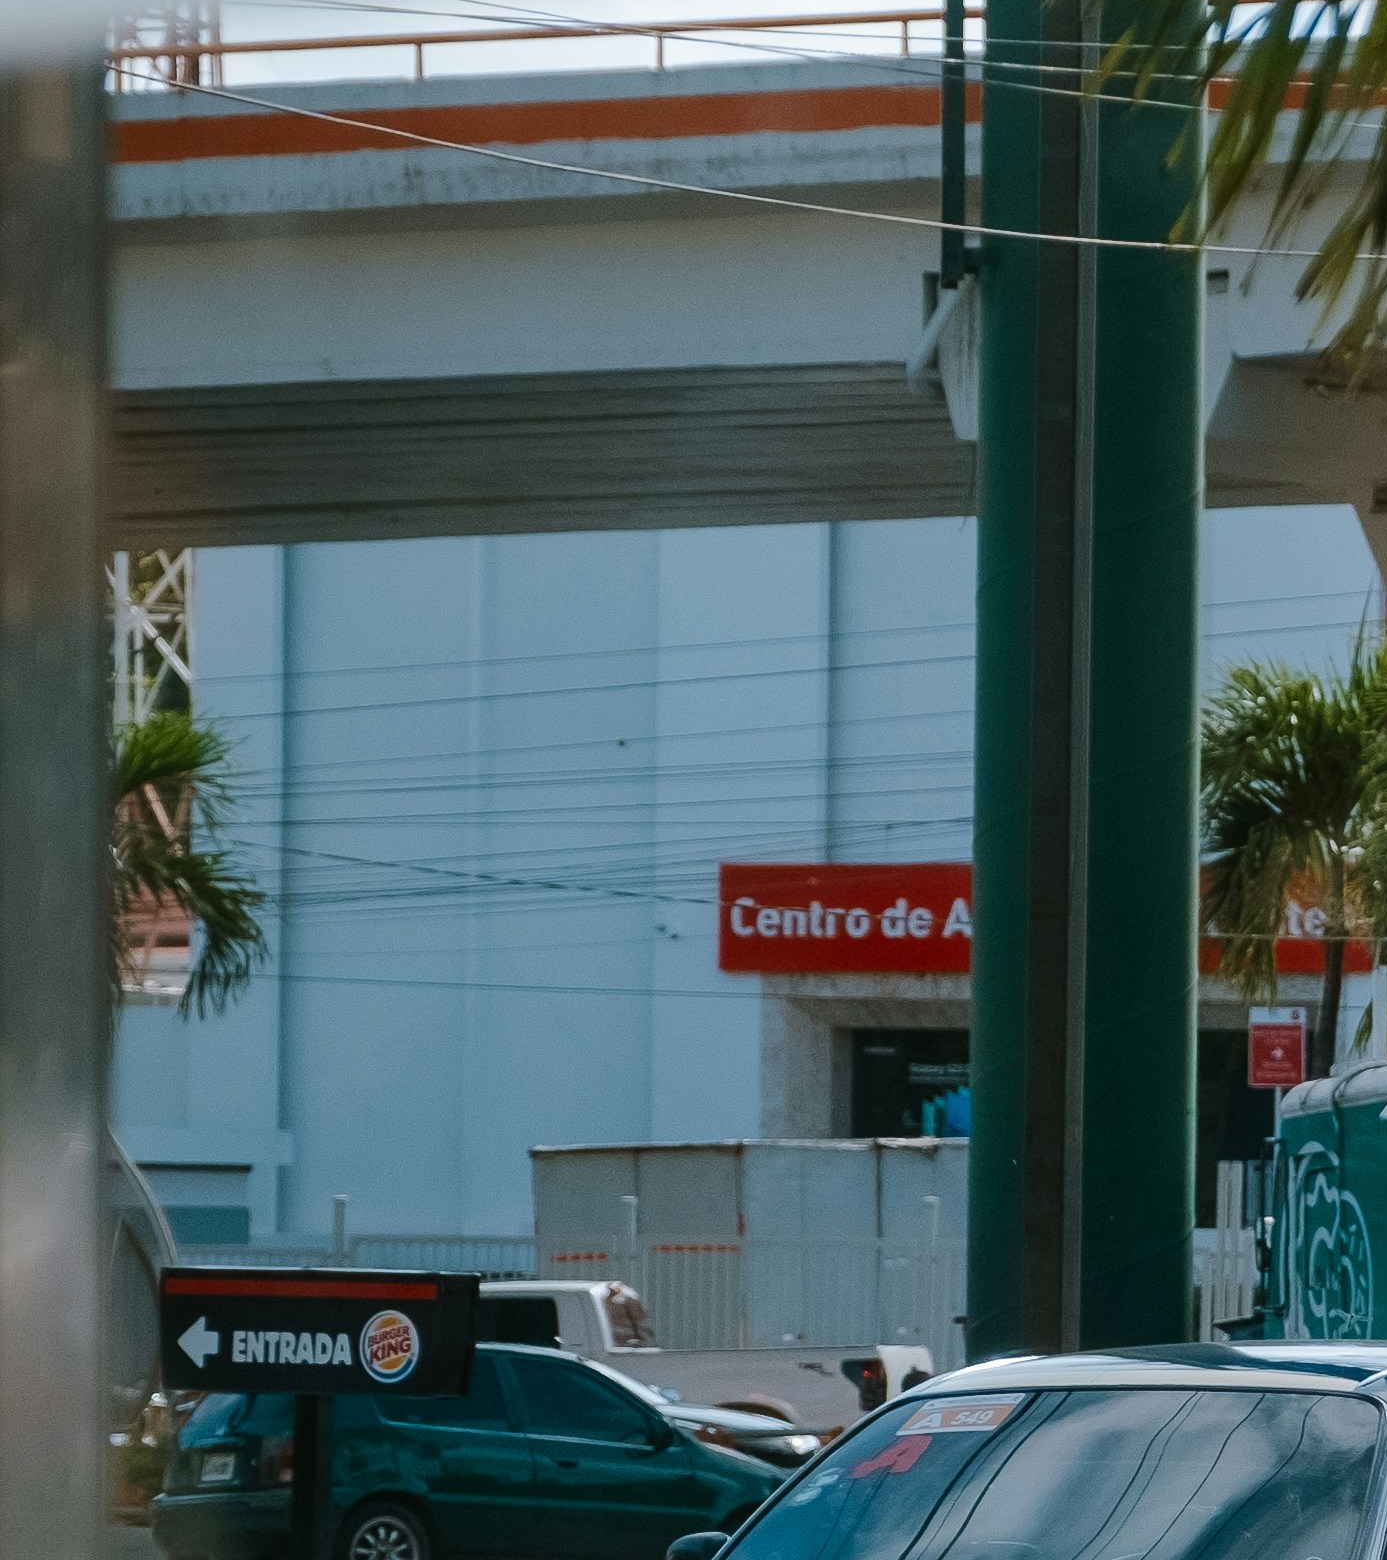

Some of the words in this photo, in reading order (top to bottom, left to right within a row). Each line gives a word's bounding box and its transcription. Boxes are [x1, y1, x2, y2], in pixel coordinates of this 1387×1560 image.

[731, 897, 871, 938] Centro
[881, 897, 934, 938] de
[232, 1330, 352, 1366] ENTRADA
[369, 1336, 412, 1366] KING
[950, 1409, 995, 1426] 549
